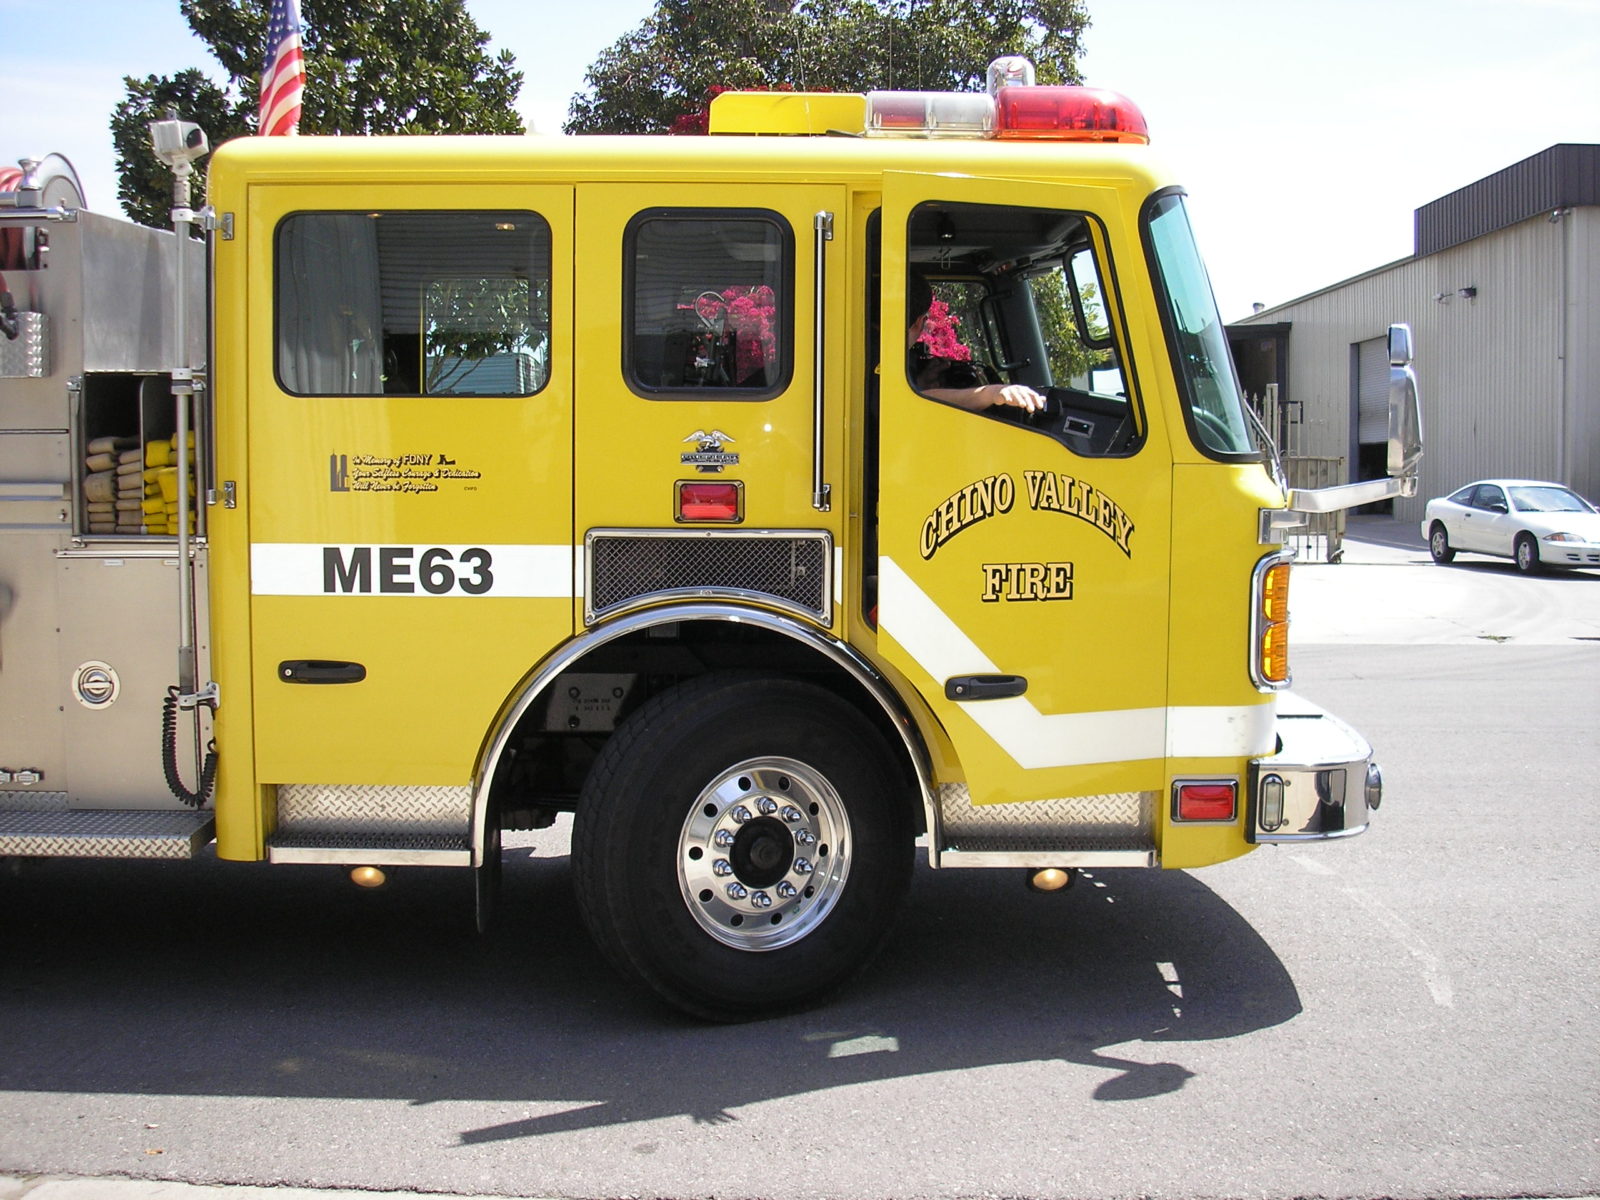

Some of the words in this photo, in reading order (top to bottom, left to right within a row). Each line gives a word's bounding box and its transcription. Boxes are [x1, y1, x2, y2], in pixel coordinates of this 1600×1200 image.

[352, 468, 372, 480] Your
[372, 468, 402, 481] Selfless
[402, 468, 433, 481] Courage
[433, 469, 441, 478] &
[441, 468, 481, 479] Dedication
[363, 455, 393, 467] Memory
[393, 455, 403, 468] of
[403, 454, 433, 465] FDNY
[352, 481, 370, 491] Will
[370, 481, 392, 492] Never
[392, 481, 402, 491] be
[402, 481, 438, 494] Forgotten
[919, 472, 1015, 560] CHINO
[1023, 470, 1135, 559] VALLEY
[323, 547, 494, 595] ME63
[981, 562, 1073, 602] FIRE
